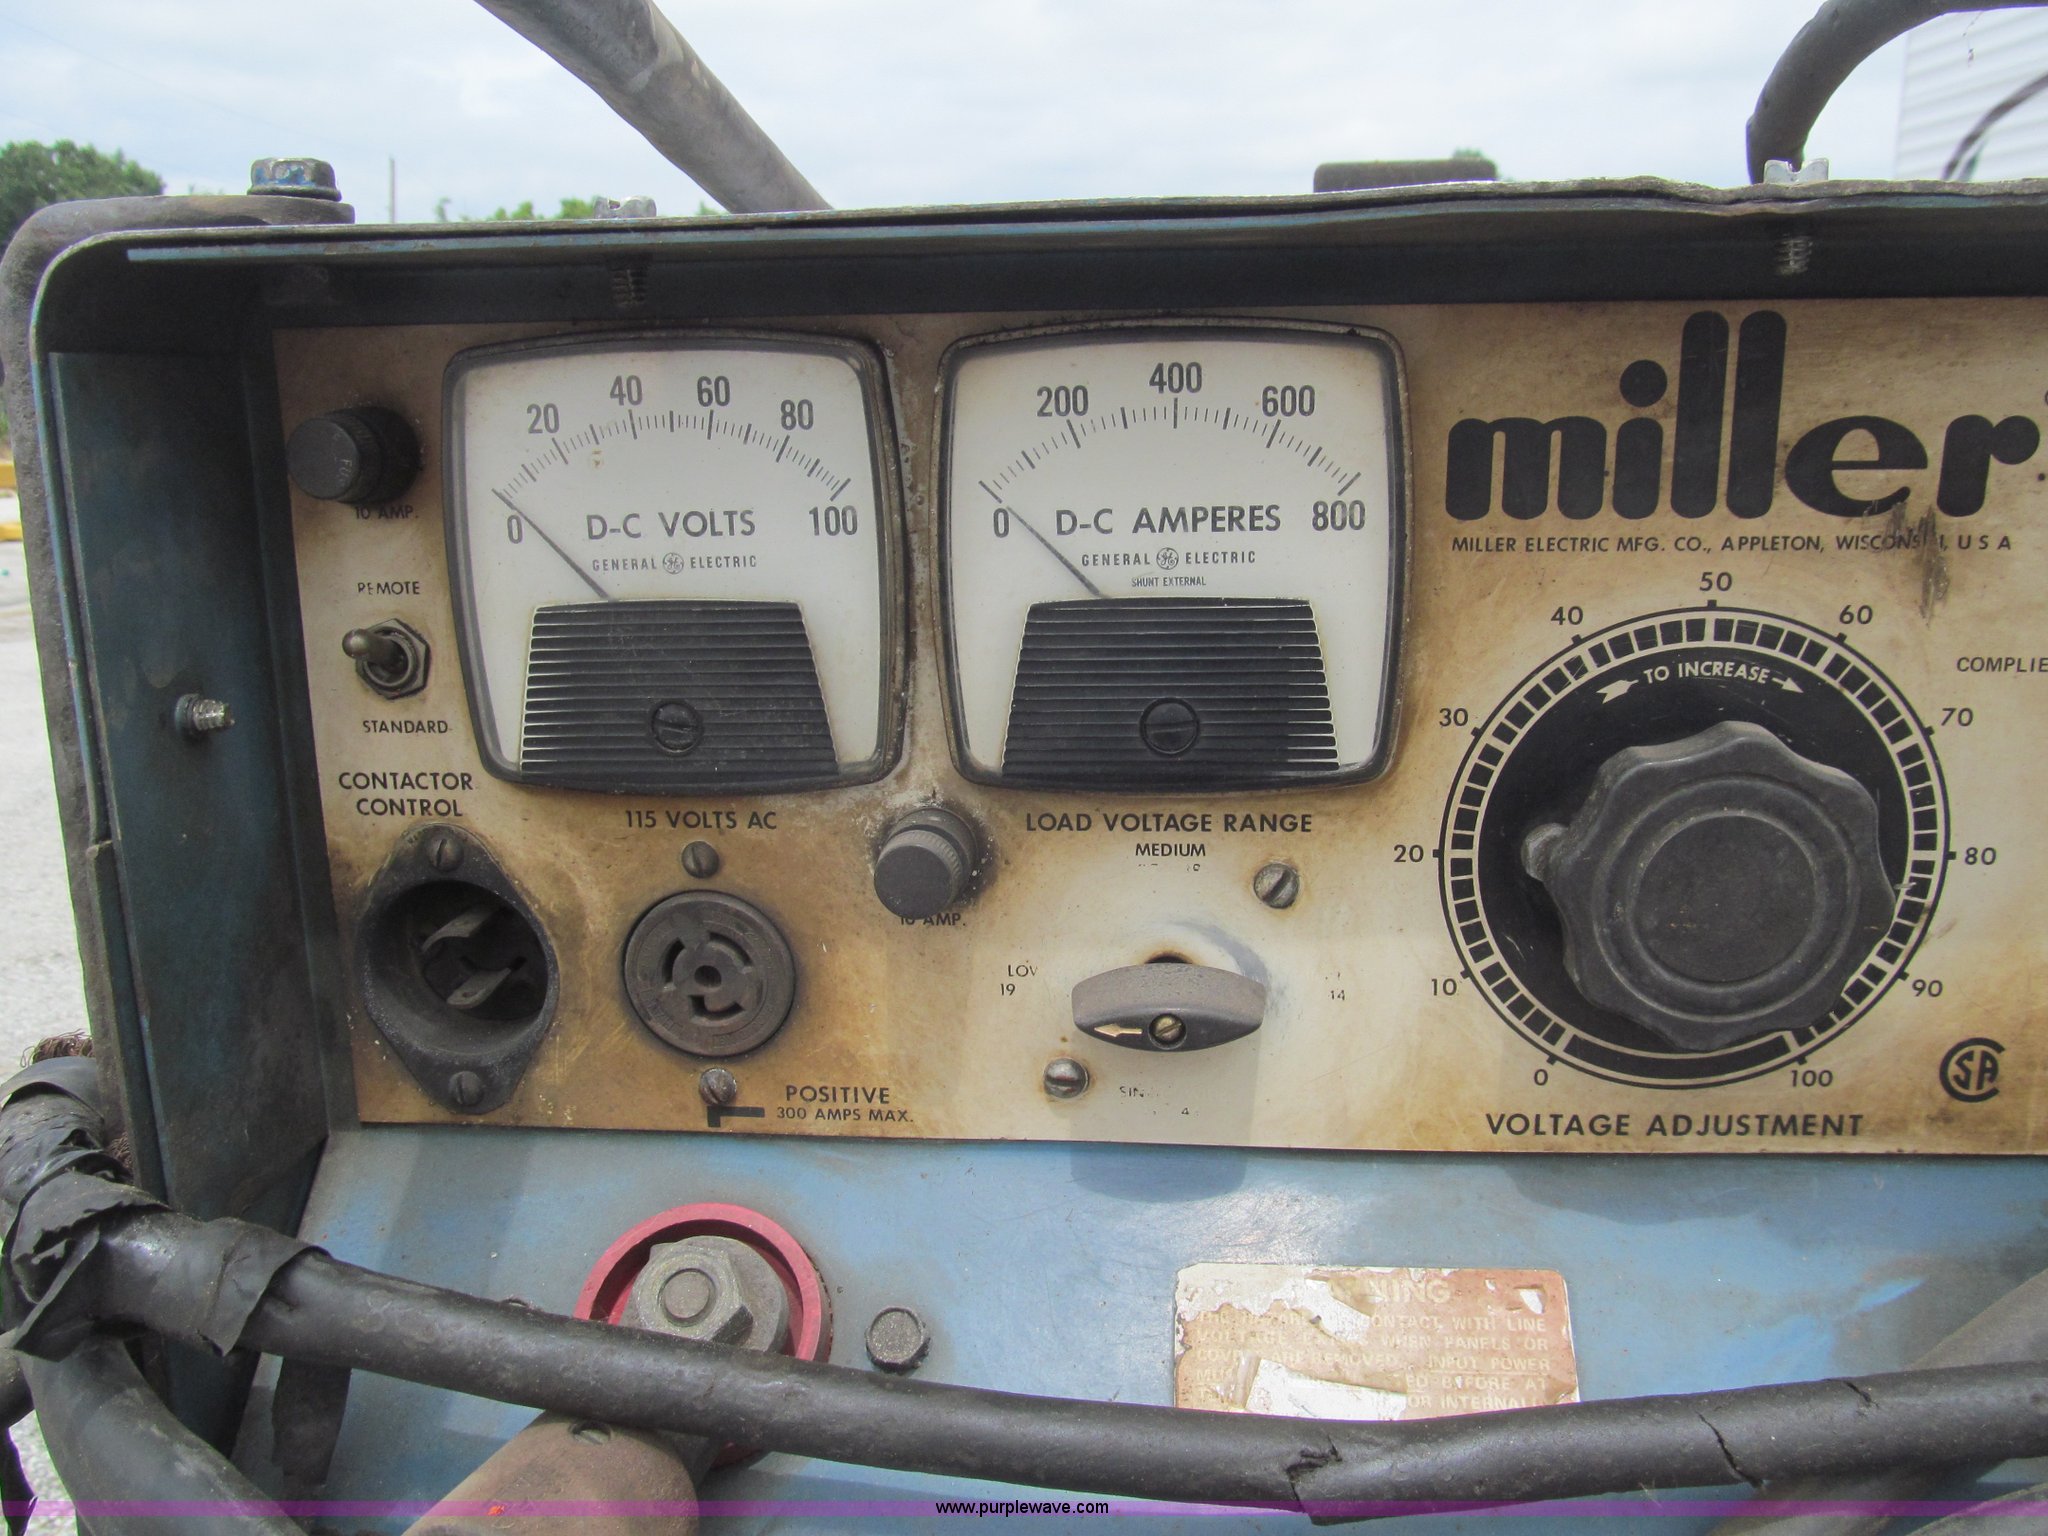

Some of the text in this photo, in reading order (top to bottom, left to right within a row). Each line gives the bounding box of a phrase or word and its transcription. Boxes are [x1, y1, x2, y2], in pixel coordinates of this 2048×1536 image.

[1149, 361, 1203, 394] 400
[609, 375, 643, 406] 40
[696, 375, 731, 407] 60
[1261, 384, 1316, 417] 600
[1036, 385, 1090, 418] 200
[526, 403, 559, 434] 20
[780, 399, 814, 430] 80
[1445, 309, 2041, 521] miller
[586, 509, 756, 540] D-C VOLTS
[808, 506, 858, 536] 100
[993, 508, 1010, 538] 0
[1055, 504, 1282, 536] D-C AMPERES
[1312, 500, 1366, 532] 800
[507, 514, 523, 544] 0
[1451, 536, 1516, 552] MILLER
[1525, 536, 1609, 552] ELECTRIC
[1616, 536, 1665, 552] MFG.
[1720, 535, 1824, 554] APPLETON,
[592, 558, 657, 572] GENERAL
[690, 555, 758, 570] ELECTRIC
[1081, 551, 1151, 567] GENERAL
[1185, 549, 1256, 565] ELECTRIC
[1131, 576, 1207, 587] SHUNT EXTERNAL
[1699, 571, 1733, 592] 50
[1551, 606, 1584, 627] 40
[1839, 605, 1873, 626] 60
[1643, 660, 1771, 684] TO INCREASE
[362, 720, 448, 734] STANDARD
[1438, 708, 1469, 729] 30
[1941, 707, 1974, 728] 70
[338, 772, 473, 791] CONTACTOR
[356, 798, 463, 817] CONTROL
[625, 810, 777, 829] 115 VOLTS AC
[1026, 813, 1313, 833] LOAD VOLTAGE RANGE
[1135, 843, 1206, 857] MEDIUM
[1393, 844, 1425, 864] 20
[1964, 846, 1997, 867] 80
[923, 912, 966, 926] AMP.
[1431, 977, 1458, 997] 10
[1911, 978, 1944, 998] 90
[1533, 1068, 1549, 1087] 0
[1791, 1068, 1833, 1088] 100
[786, 1085, 890, 1104] POSITIVE
[777, 1107, 914, 1122] 300 AMPS MAX.
[1486, 1113, 1864, 1137] VOLTAGE ADJUSTMENT
[1362, 1314, 1440, 1330] ONTACT
[1507, 1317, 1547, 1333] LINE
